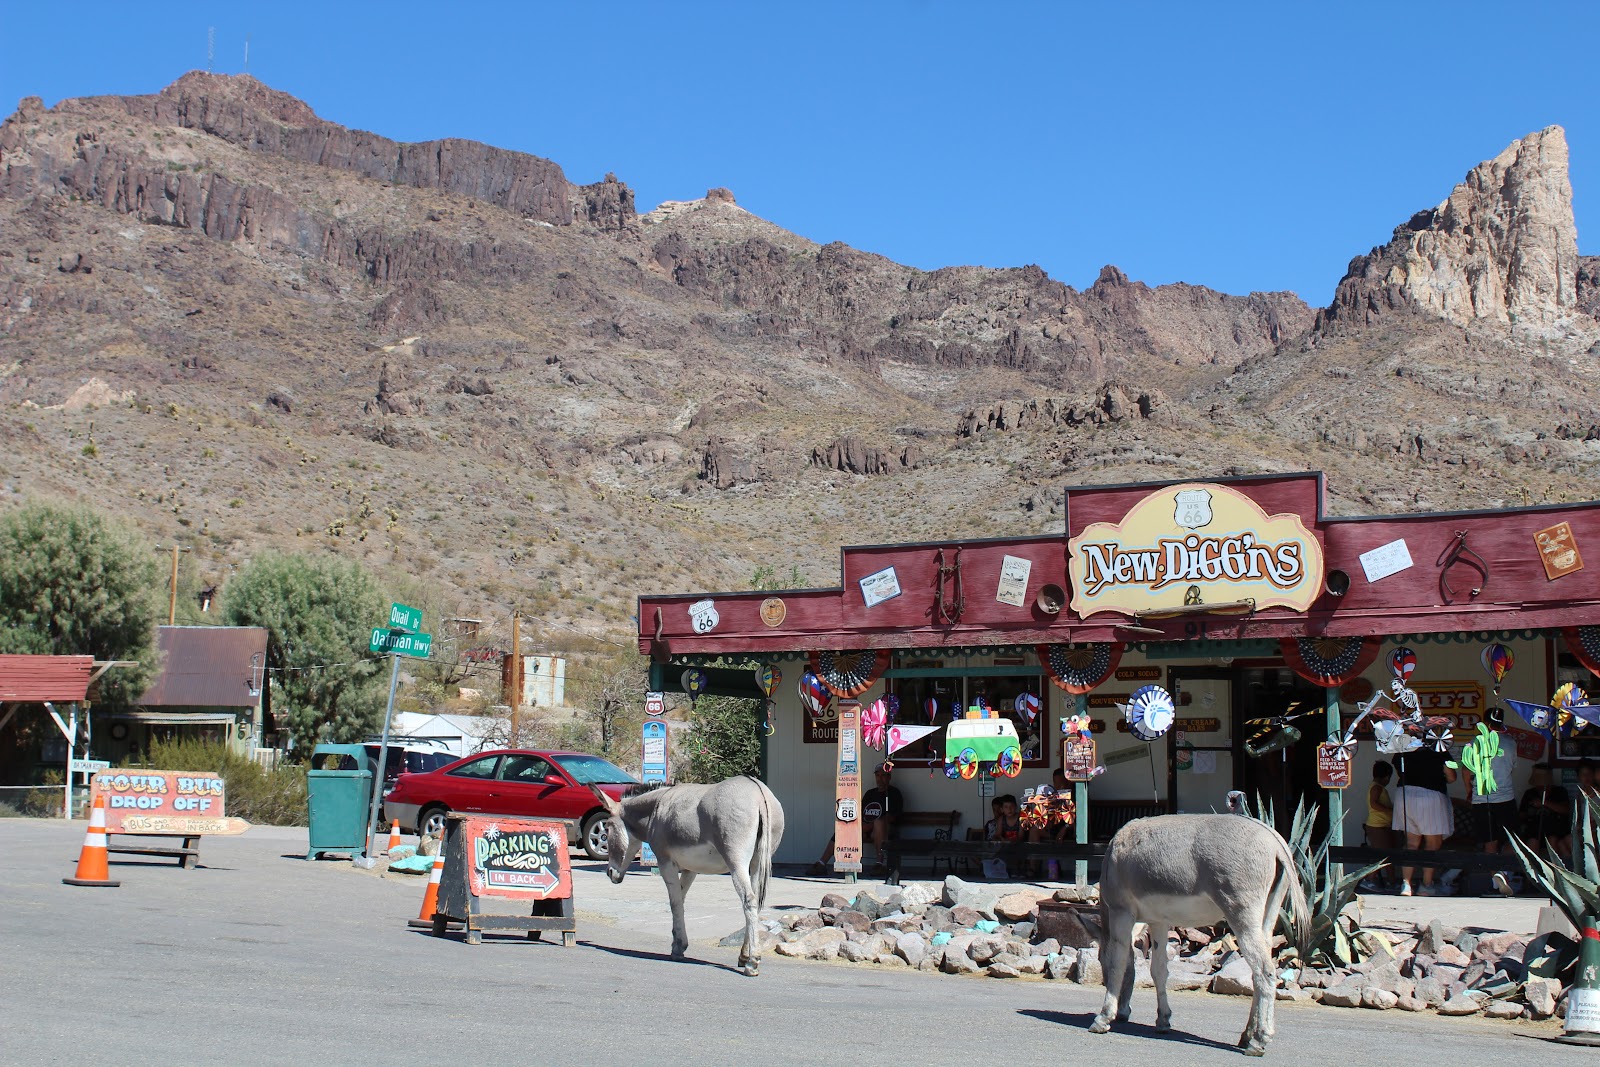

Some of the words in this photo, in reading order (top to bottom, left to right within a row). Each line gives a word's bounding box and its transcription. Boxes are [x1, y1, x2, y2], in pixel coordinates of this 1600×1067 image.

[1182, 494, 1204, 502] ROUTE
[1183, 510, 1203, 524] 66
[1081, 543, 1160, 595] New
[691, 602, 710, 614] ROUTE
[391, 606, 410, 626] Quail
[412, 618, 420, 630] Dr
[698, 611, 708, 619] US
[699, 616, 714, 630] 66
[371, 629, 412, 650] Oatman
[413, 639, 430, 654] Hwy
[1066, 699, 1076, 709] 66
[1413, 691, 1479, 708] IFT
[648, 702, 661, 711] 66
[812, 728, 839, 739] ROUTE
[96, 774, 168, 794] TOUR
[176, 777, 224, 797] BUS
[110, 795, 164, 809] DROP
[173, 797, 212, 811] OFF
[841, 810, 854, 818] 66
[129, 818, 152, 830] BUS
[198, 824, 223, 832] BACK
[475, 834, 549, 871] PARKING
[494, 873, 505, 882] IN
